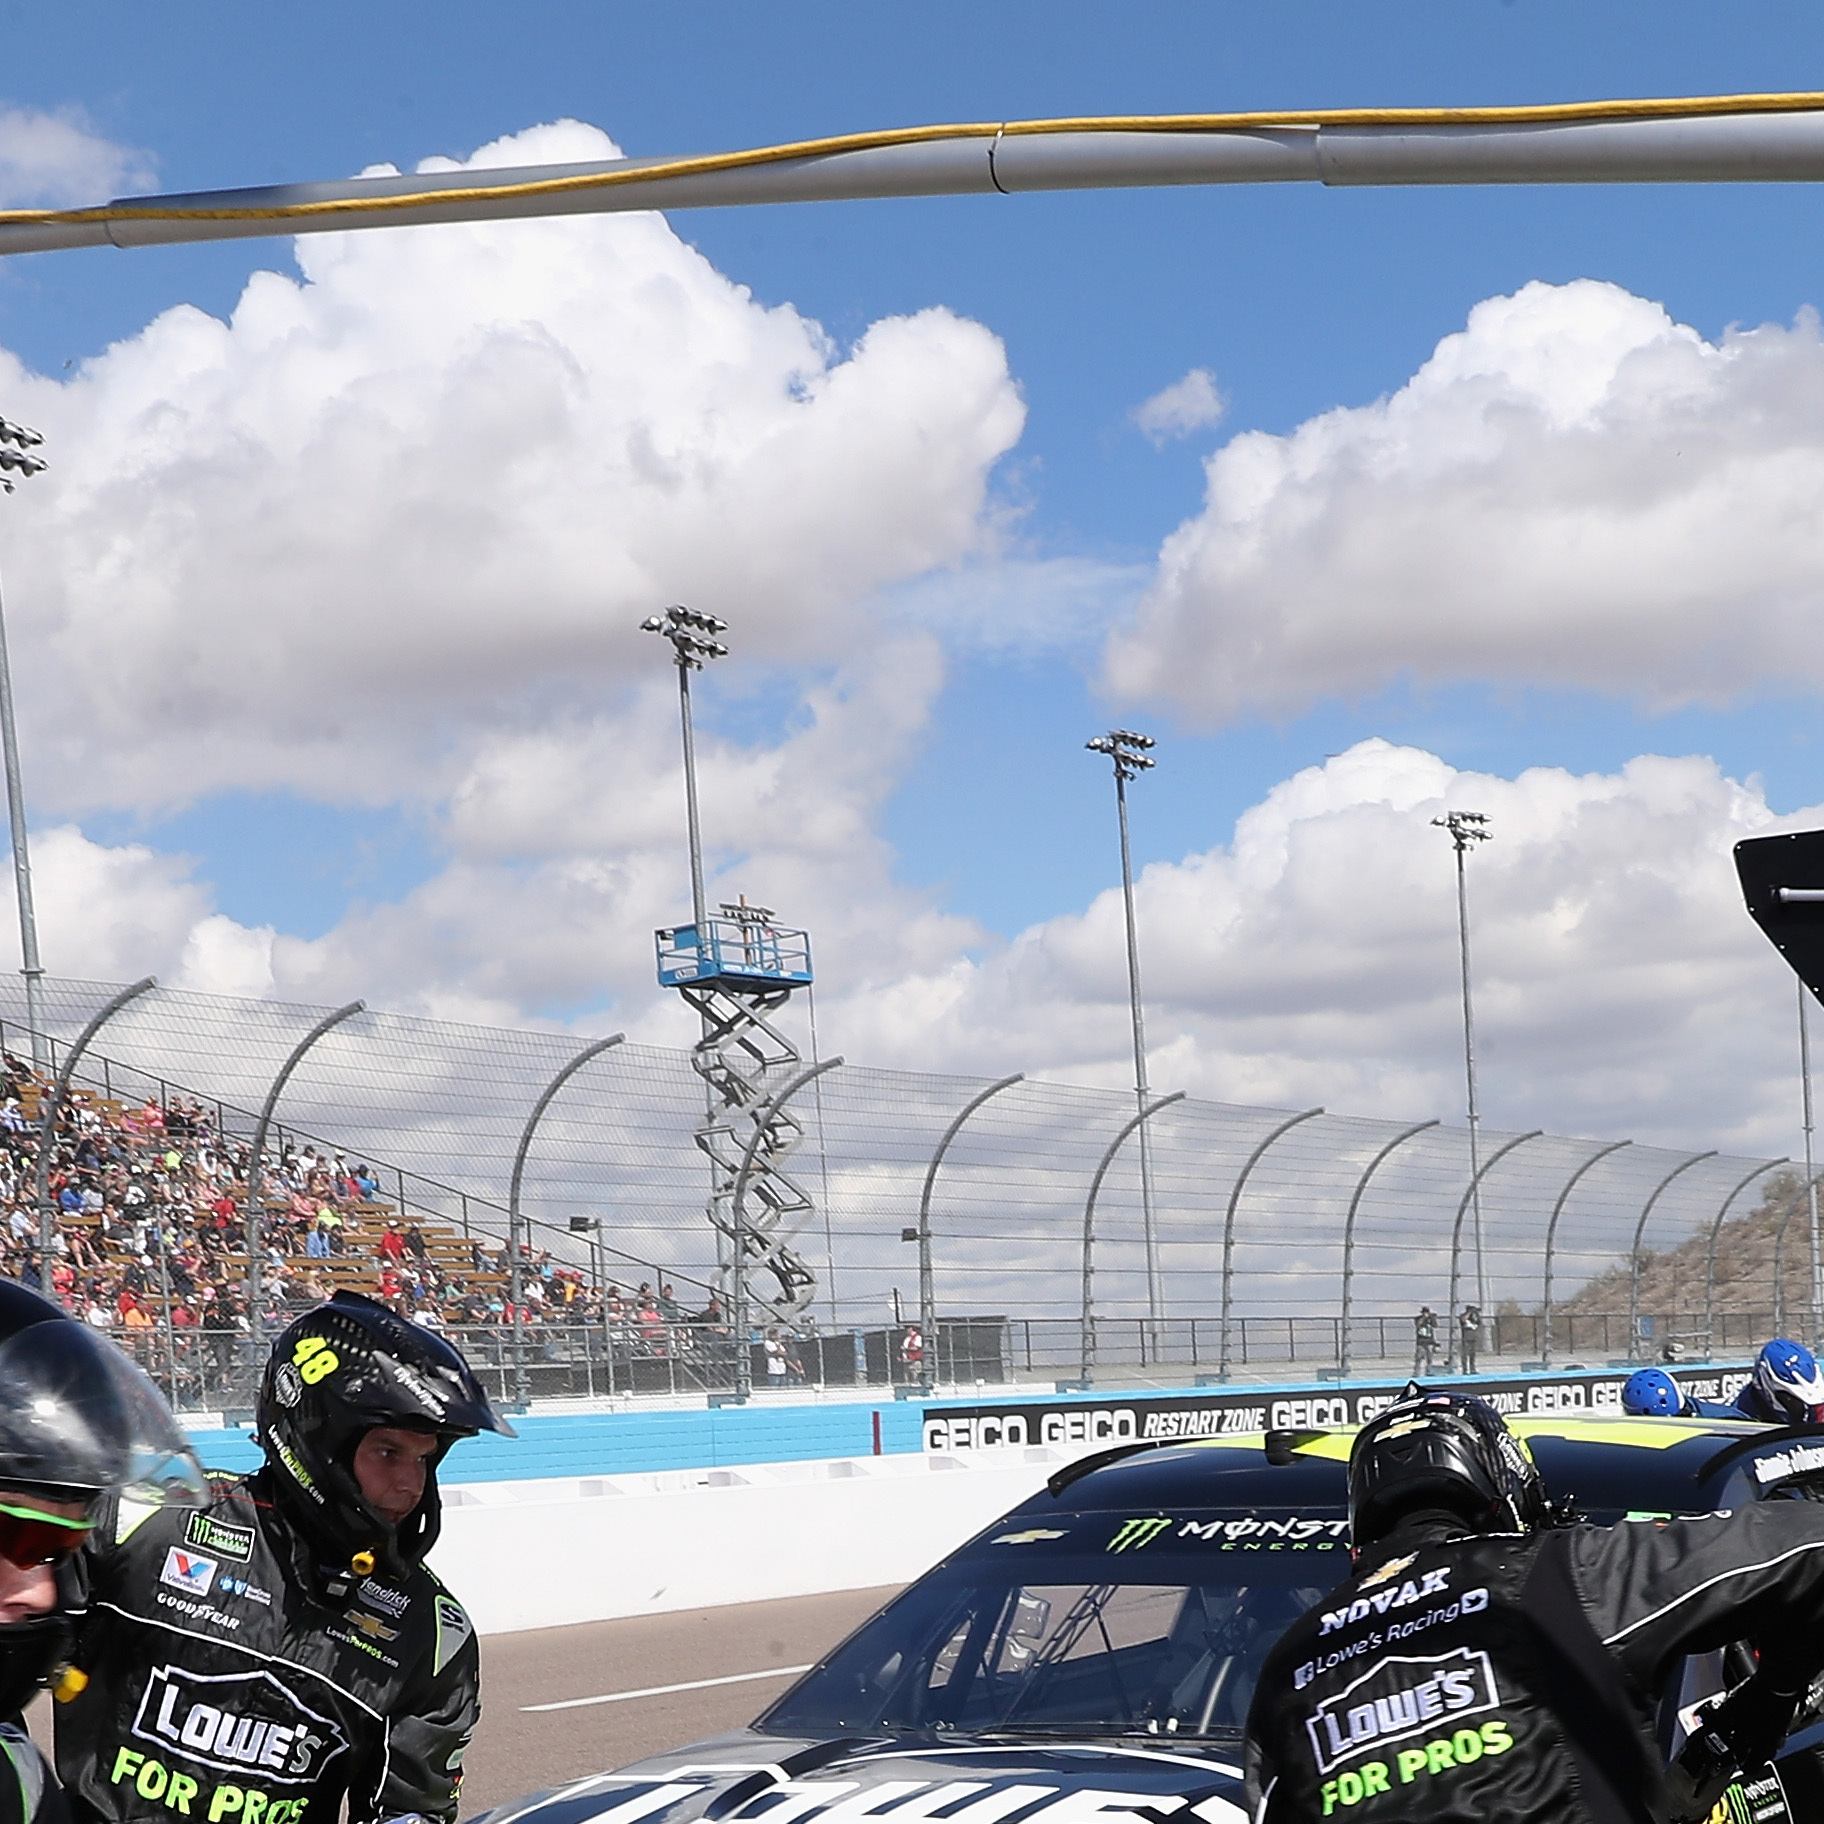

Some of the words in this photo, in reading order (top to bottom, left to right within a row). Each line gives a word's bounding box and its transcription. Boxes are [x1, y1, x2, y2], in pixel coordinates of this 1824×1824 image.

[292, 1337, 339, 1385] 48
[923, 1413, 1029, 1453] GEICO
[1041, 1408, 1137, 1446] GEICO
[1143, 1410, 1222, 1438] RESTART
[1220, 1406, 1267, 1433] ZONE
[1271, 1398, 1348, 1431] GEICO
[1527, 1384, 1584, 1412] GEICO
[156, 1592, 241, 1631] GOODYEAR
[1318, 1566, 1452, 1637] NOVAK
[1316, 1630, 1383, 1676] Lowe's
[1385, 1599, 1460, 1644] Racing
[156, 1683, 323, 1774] LOWE'S
[1326, 1666, 1476, 1757] LOWE'S
[111, 1746, 198, 1815] FOR
[1319, 1761, 1393, 1818] FOR
[1396, 1720, 1515, 1785] PROS
